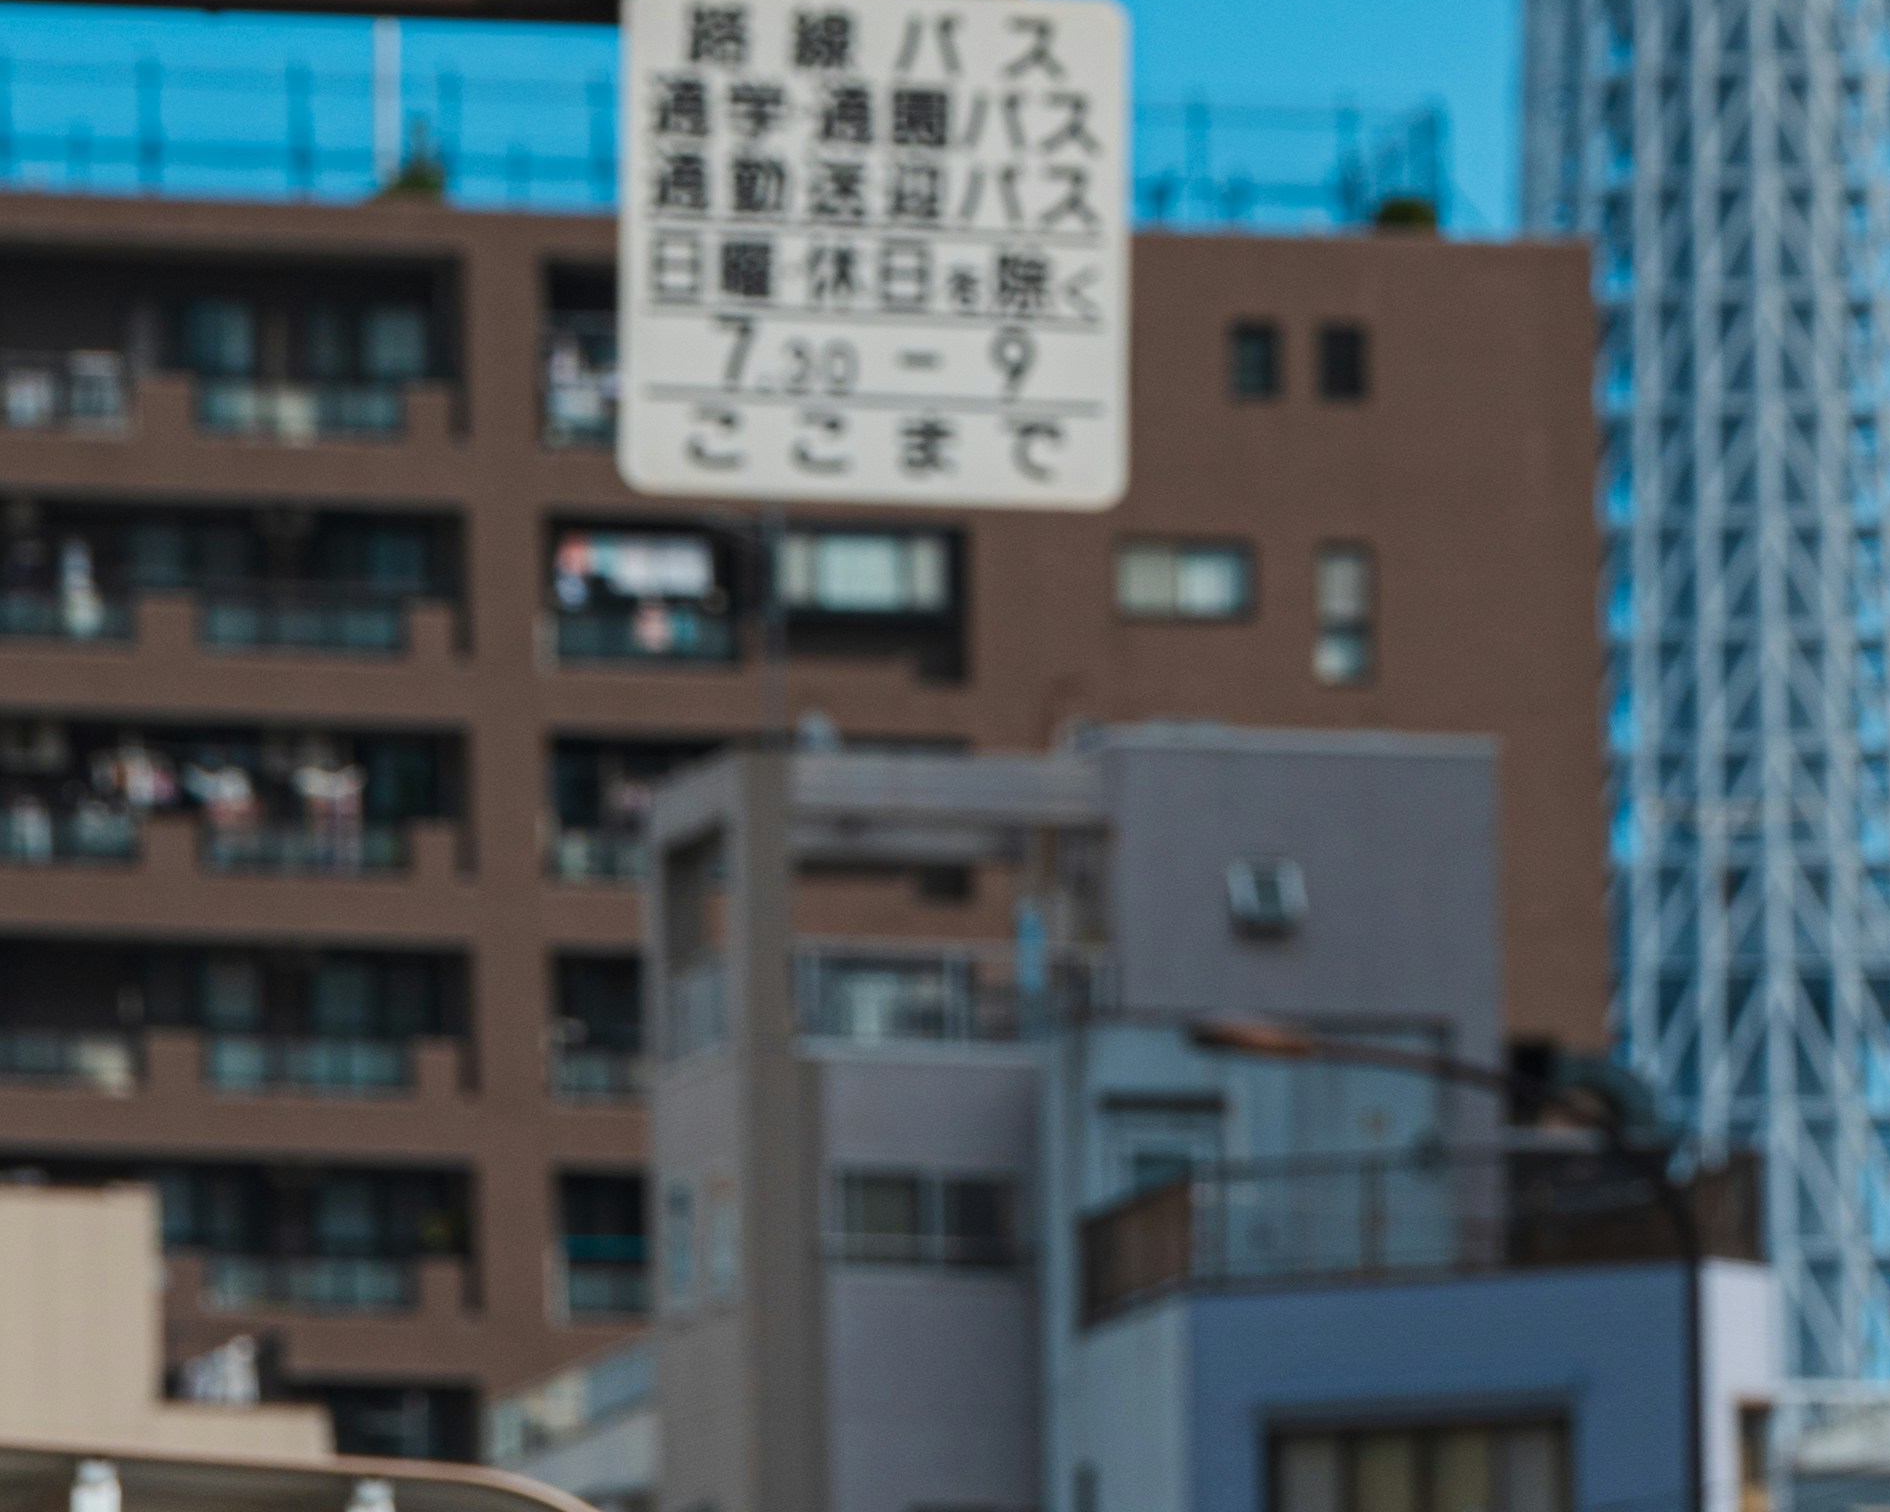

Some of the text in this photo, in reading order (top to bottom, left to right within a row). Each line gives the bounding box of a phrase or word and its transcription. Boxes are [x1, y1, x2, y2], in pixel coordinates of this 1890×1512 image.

[689, 6, 1065, 80] 路線バス
[654, 151, 1100, 226] 通勤送迎バス
[685, 406, 1066, 484] ここまで
